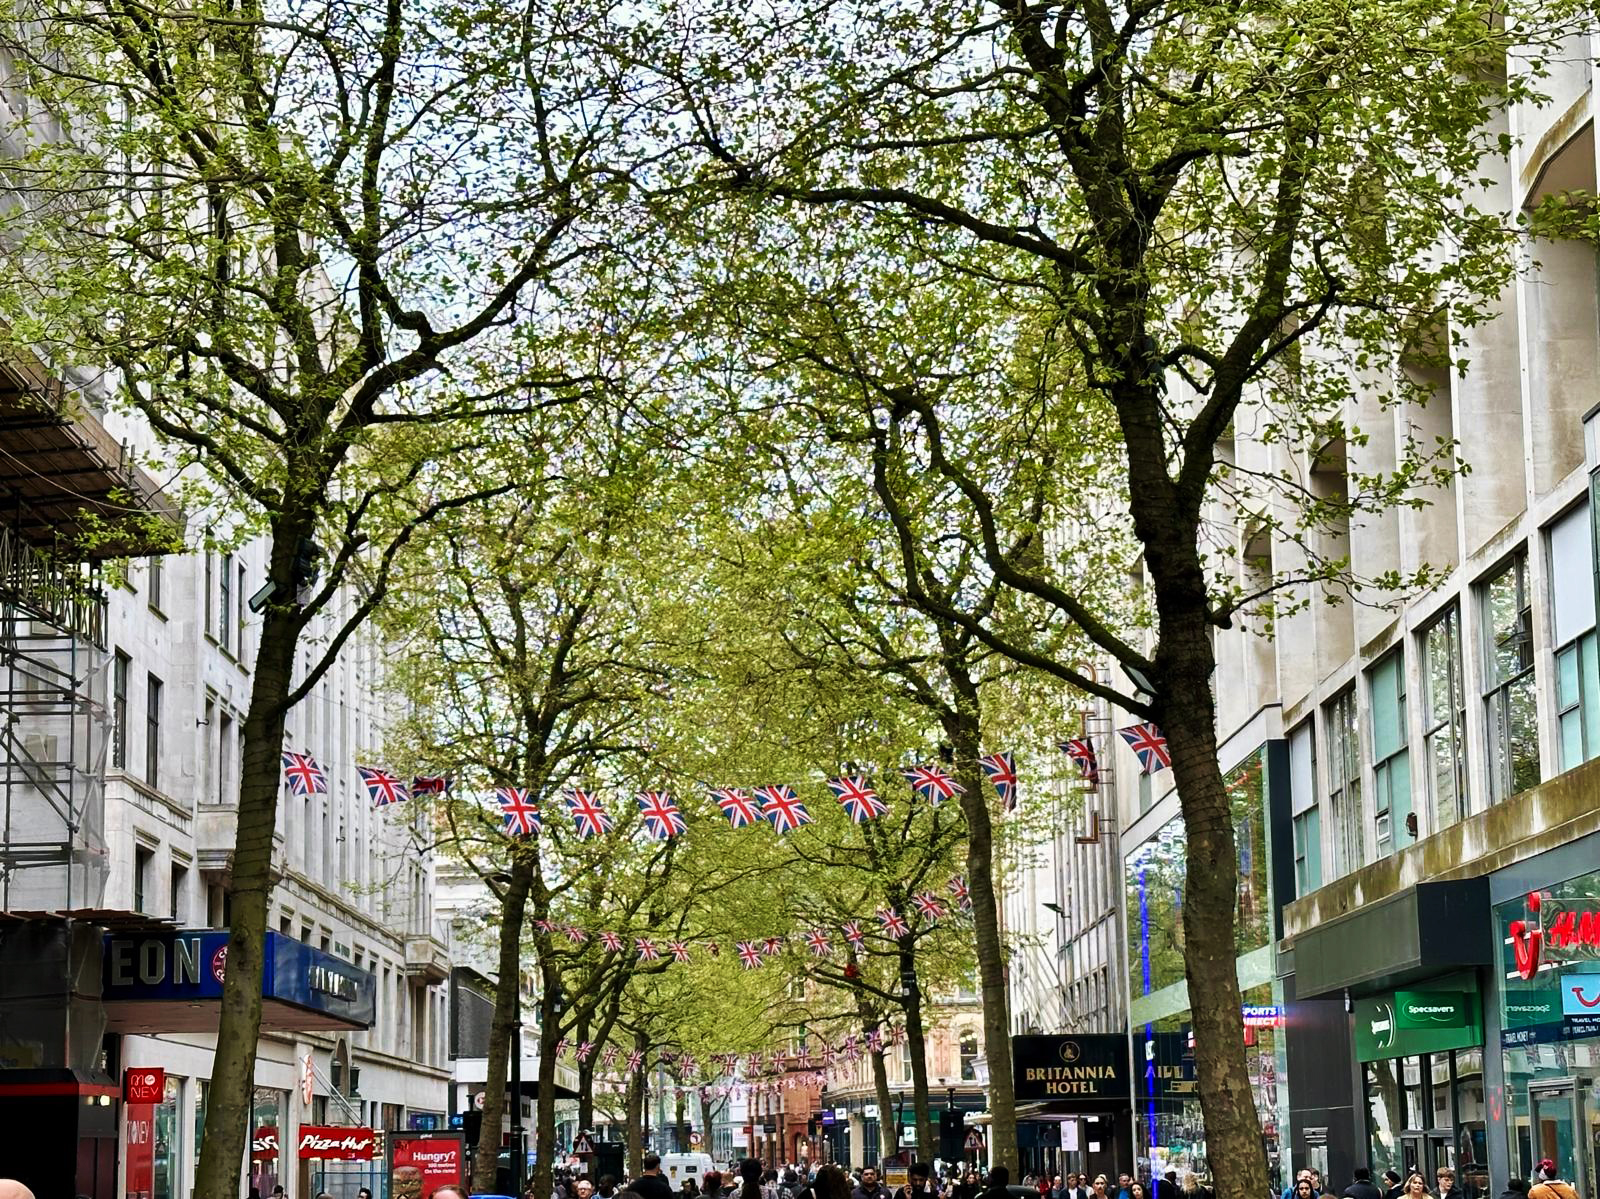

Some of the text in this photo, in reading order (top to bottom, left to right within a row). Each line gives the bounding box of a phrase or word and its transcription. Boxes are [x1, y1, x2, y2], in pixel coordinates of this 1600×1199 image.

[1242, 1007, 1276, 1015] PORTS
[1408, 1005, 1455, 1014] Specsavers
[1026, 1066, 1116, 1081] BRITANNIA
[1046, 1081, 1098, 1094] HOTEL
[299, 1134, 373, 1150] Pizza Hut
[413, 1151, 456, 1162] Hungry?
